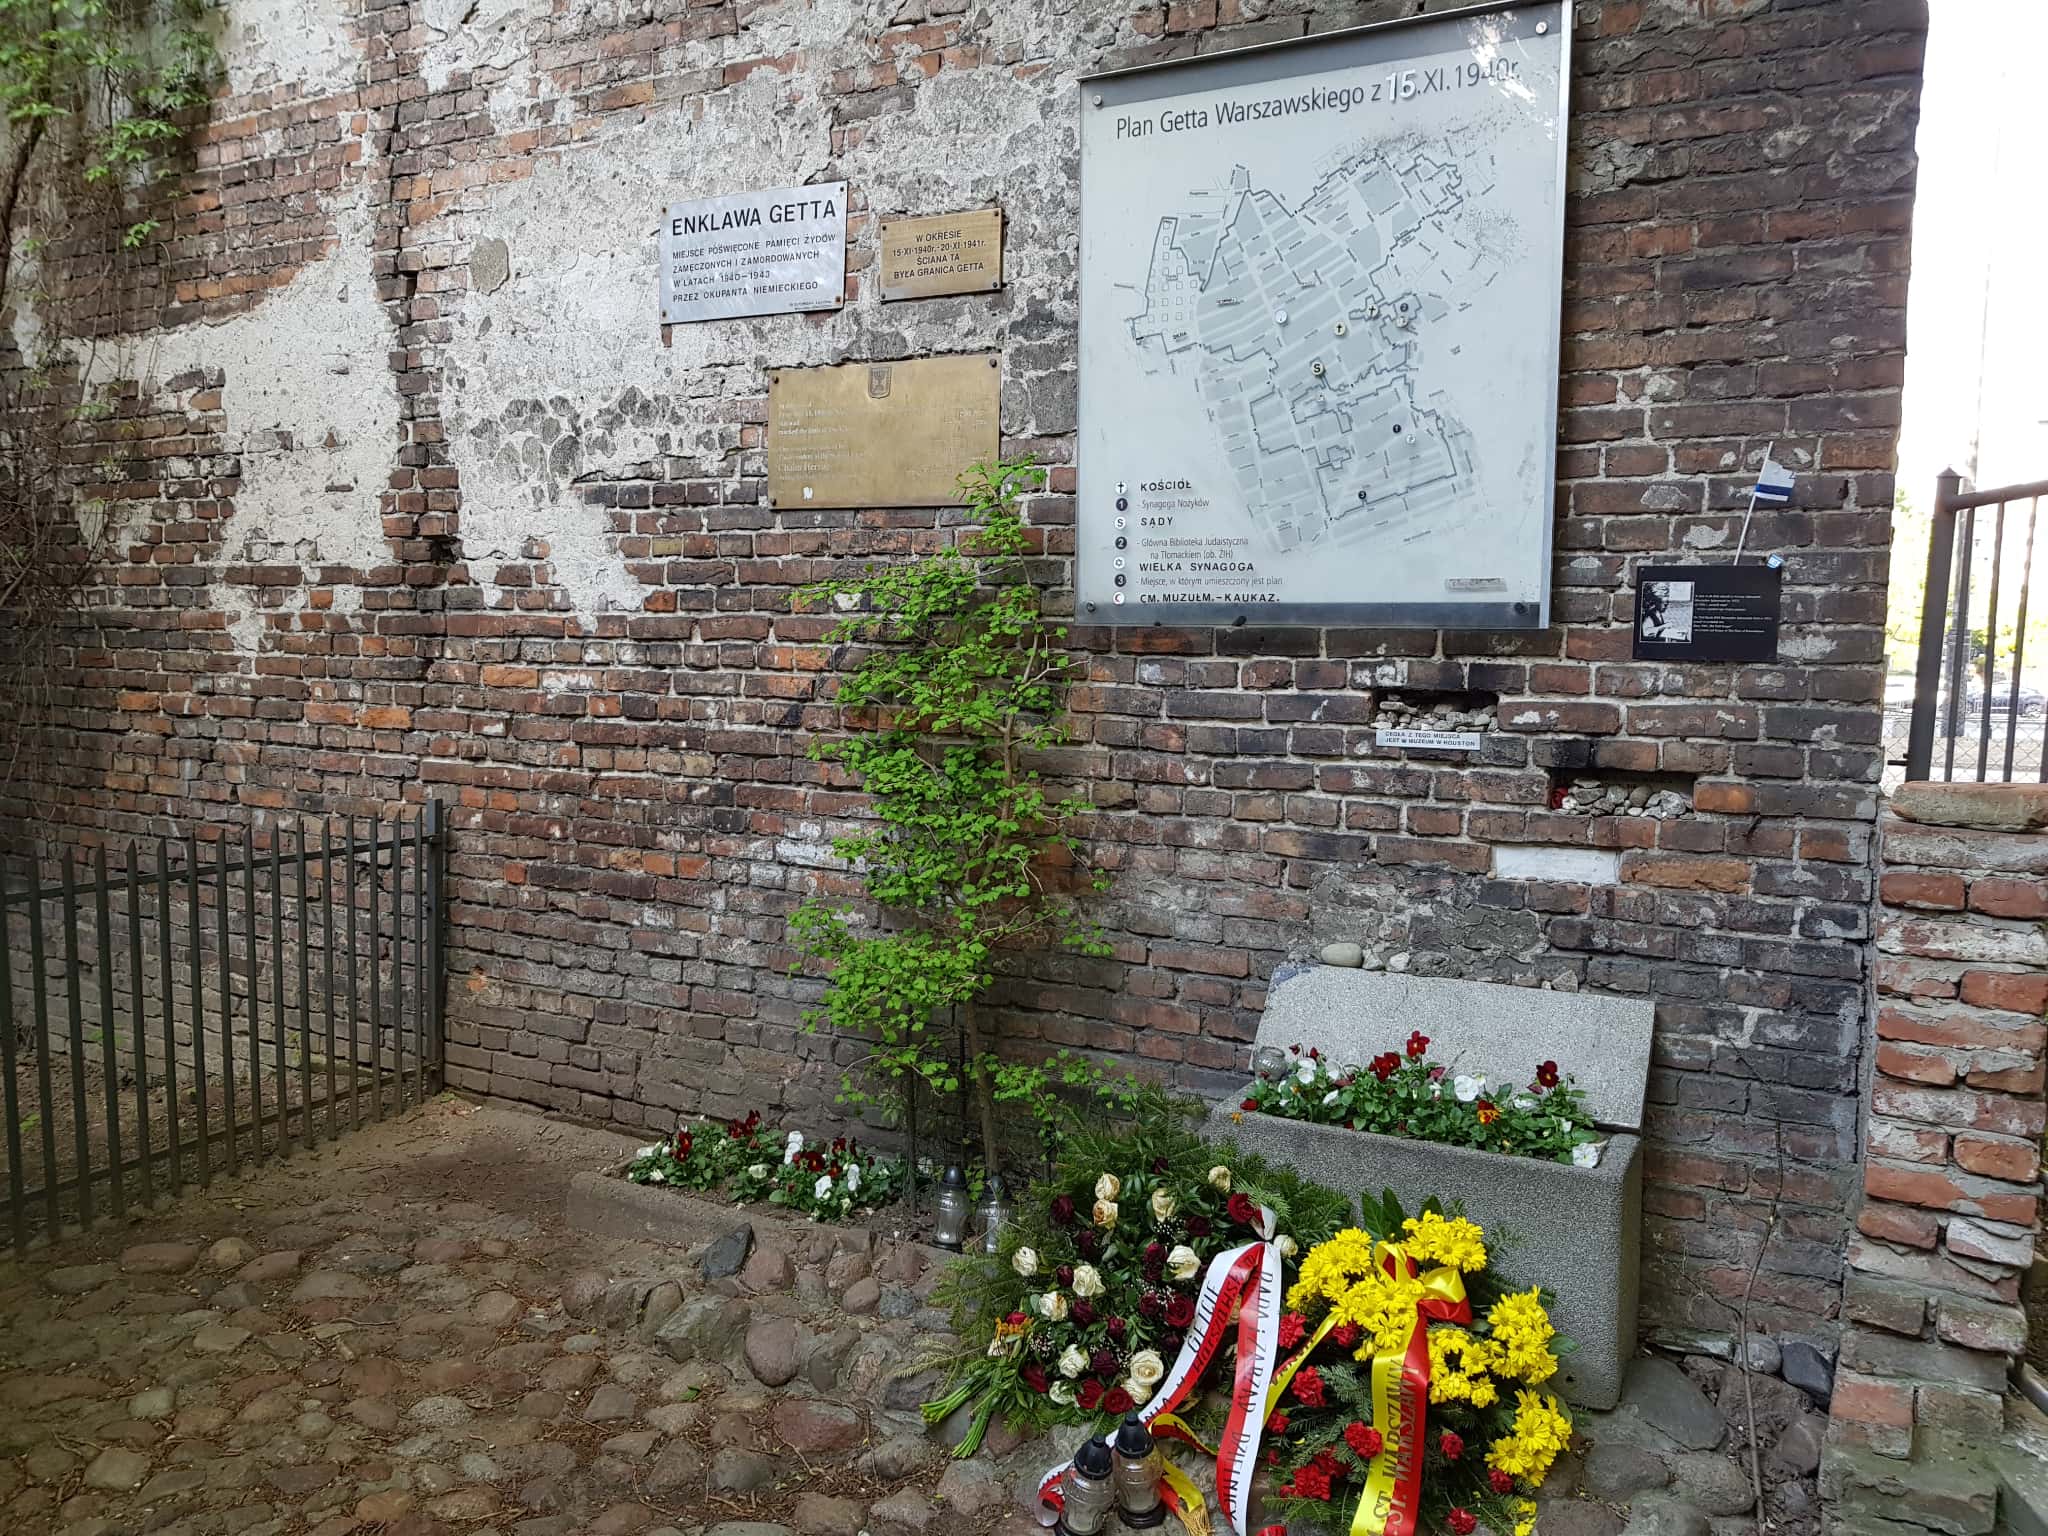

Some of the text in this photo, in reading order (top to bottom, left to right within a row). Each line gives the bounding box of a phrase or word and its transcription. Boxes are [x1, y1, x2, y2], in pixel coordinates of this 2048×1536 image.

[1117, 115, 1153, 139] Plan
[1160, 110, 1208, 133] Getta
[1215, 86, 1364, 125] Warszawskiego
[1371, 84, 1382, 102] z
[672, 199, 836, 236] ENKLAWA GETTA
[916, 230, 962, 243] W OKRESIE
[673, 248, 705, 260] MIEJSCE
[708, 241, 760, 255] POŚWIĘCONE
[804, 233, 836, 245] ŻYDÓW
[741, 250, 820, 266] ZAMORDOWANYCH
[917, 253, 960, 266] ŚCIANA TA
[894, 269, 915, 279] BYŁA
[957, 262, 984, 273] GETTA
[673, 279, 681, 288] W
[683, 276, 715, 287] LATACH
[673, 281, 818, 303] PRZEZ OKUPANTA NIEMIECKIEGO
[1140, 478, 1192, 492] KOŚCIÓŁ
[1141, 499, 1176, 511] Synagoga
[1140, 517, 1174, 528] SĄDY
[1169, 537, 1203, 547] Biblioteka
[1204, 536, 1249, 548] Judaistyczna
[1139, 562, 1254, 572] WIELKA SYNAGOGA
[1382, 1358, 1420, 1482] WARSZAWY
